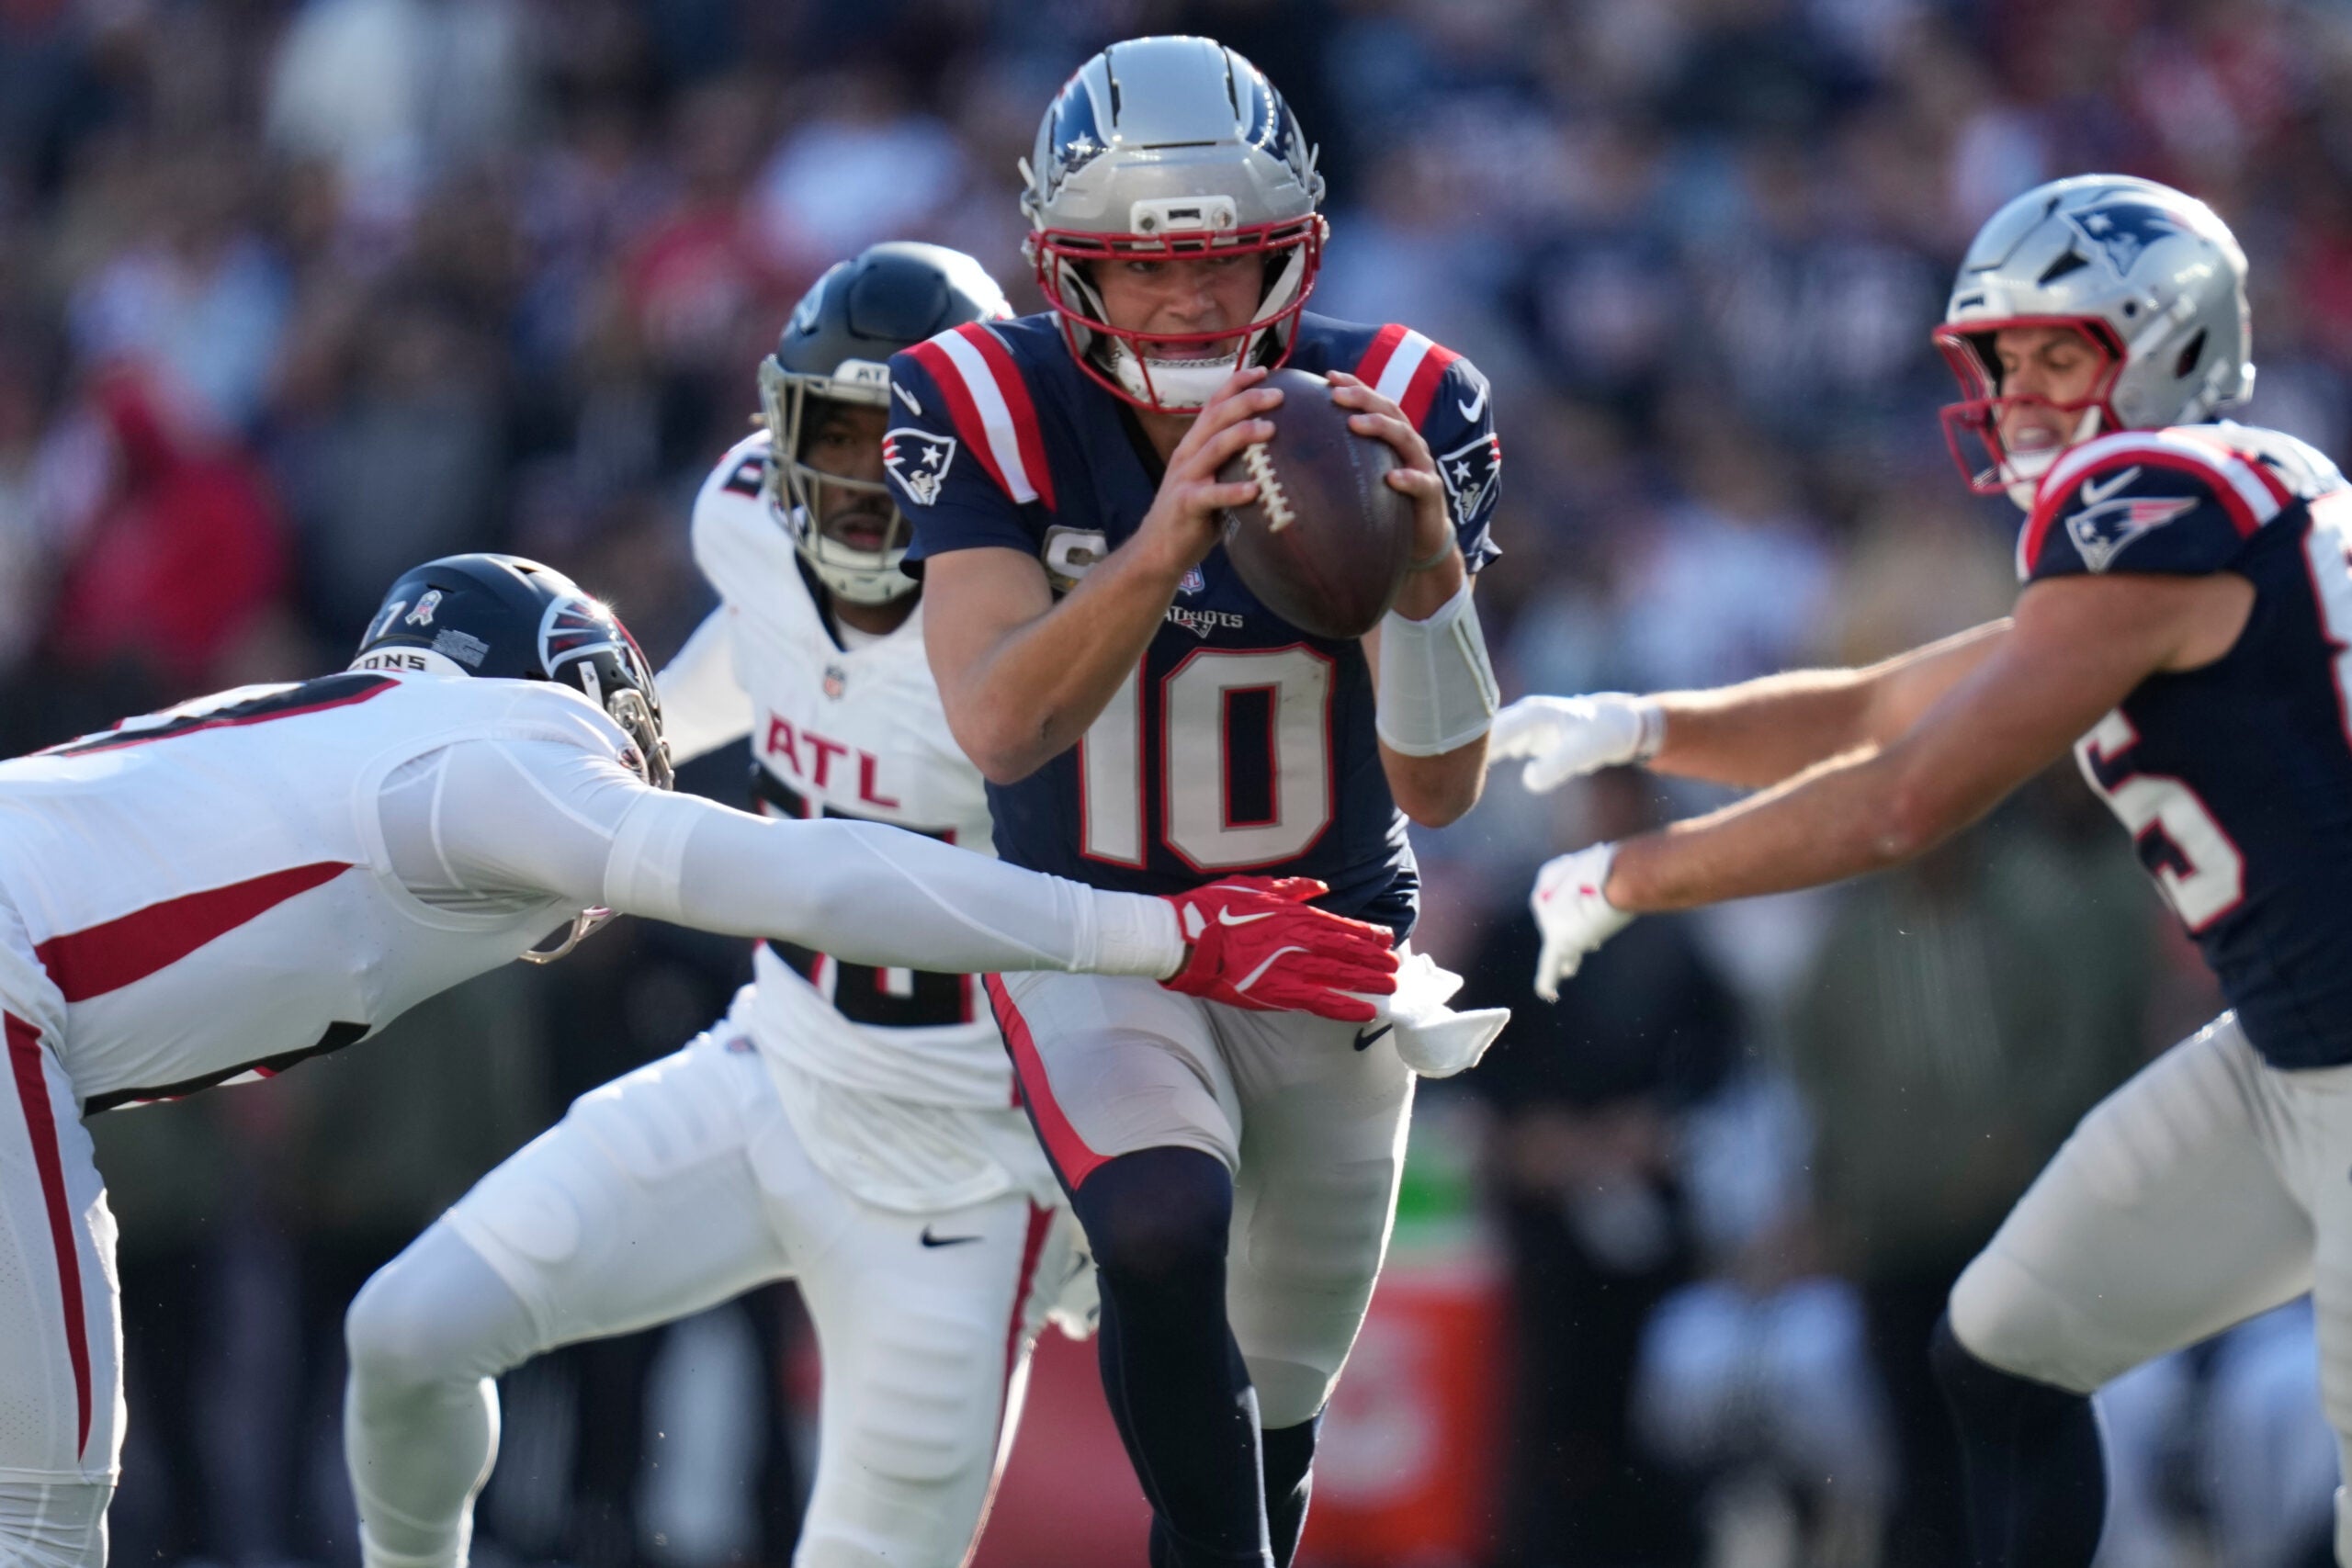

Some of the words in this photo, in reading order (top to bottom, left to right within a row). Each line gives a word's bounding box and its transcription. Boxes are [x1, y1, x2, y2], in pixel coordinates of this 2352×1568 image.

[1164, 605, 1244, 628] ATRIOTS
[351, 653, 426, 671] ONS
[767, 712, 900, 808] ATL
[1079, 641, 1337, 874] 10
